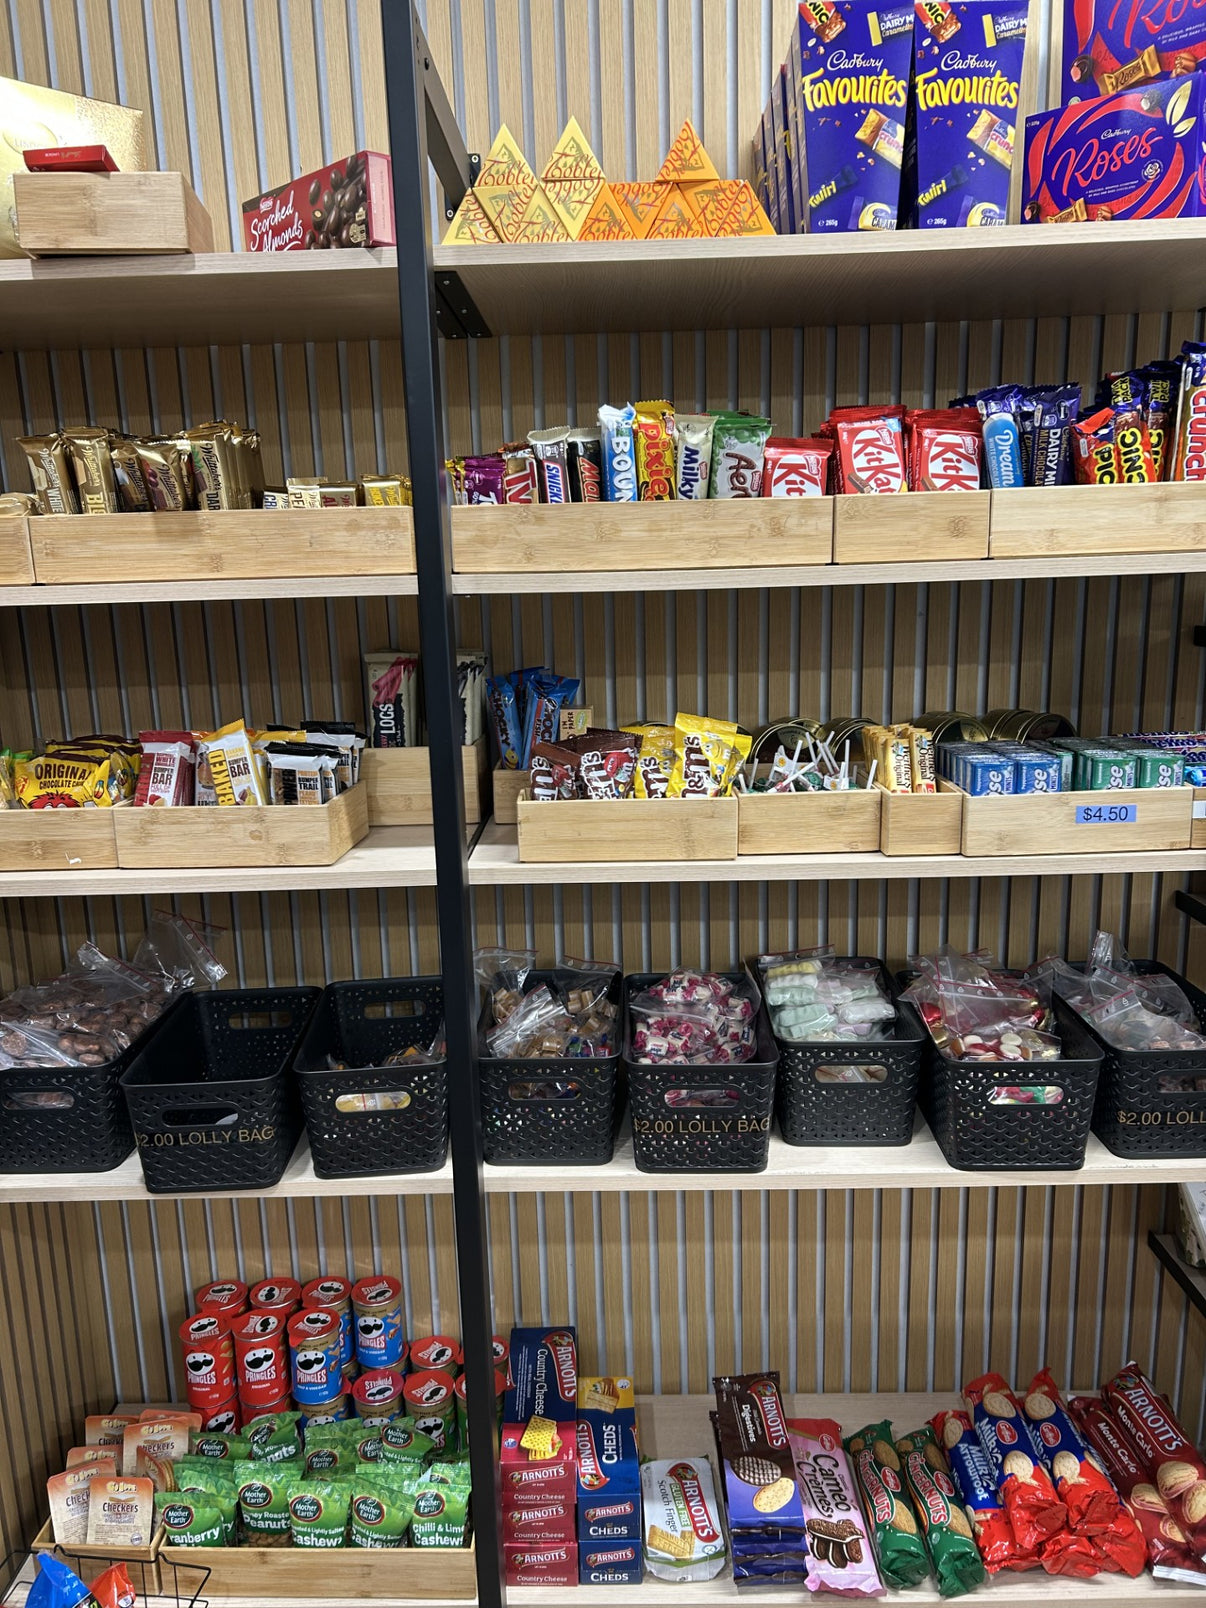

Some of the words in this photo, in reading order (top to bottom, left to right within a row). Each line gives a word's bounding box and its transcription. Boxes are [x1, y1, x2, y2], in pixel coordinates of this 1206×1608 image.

[880, 17, 905, 31] DAIRY
[994, 18, 1019, 33] DAIRY
[827, 50, 885, 72] Cadbury
[941, 50, 998, 73] Cadbury
[802, 67, 908, 113] Favourites
[915, 67, 1019, 113] Favourites
[1100, 128, 1132, 140] Cadbury
[1051, 127, 1164, 197] Roses
[250, 189, 295, 251] Scorched
[262, 212, 304, 252] Almonds
[1121, 376, 1133, 404] PACK
[994, 429, 1015, 487] Dream
[1047, 428, 1060, 470] DAIRY
[678, 445, 701, 500] Milky
[930, 441, 979, 491] KitK
[379, 702, 395, 735] LOGS
[229, 762, 250, 779] BAR
[894, 752, 905, 789] Original
[918, 746, 929, 781] Original
[152, 772, 173, 785] BAR
[208, 749, 237, 807] BAKED
[298, 782, 319, 791] TRAIL
[1083, 805, 1128, 823] $4.50
[634, 1118, 674, 1134] $2.00
[679, 1119, 733, 1133] LOLLY
[737, 1118, 771, 1133] BAG
[1117, 1110, 1162, 1126] $2.00
[1166, 1110, 1206, 1126] LOLL
[178, 1130, 232, 1147] LOLLY
[238, 1125, 276, 1143] BAG
[358, 1335, 386, 1350] PRINGLES
[533, 1347, 549, 1381] Country
[187, 1371, 217, 1386] PRINGLES
[245, 1368, 277, 1383] PRINGLES
[296, 1368, 327, 1384] PRINGLES
[534, 1382, 548, 1415] Cheese
[741, 1404, 757, 1443] Digestives
[1125, 1386, 1182, 1452] ARNOTT'S
[1117, 1405, 1134, 1432] Monte
[1131, 1430, 1154, 1458] Carlo
[202, 1443, 223, 1451] Mother
[602, 1423, 617, 1465] CHEDS
[1098, 1422, 1118, 1450] Monte
[1116, 1449, 1137, 1474] Carlo
[958, 1442, 990, 1502] Arrowroot
[669, 1481, 684, 1507] GLUTEN
[812, 1453, 852, 1514] Cameo
[859, 1449, 893, 1525] GINGERNUTS
[908, 1451, 947, 1525] GINGERNUTS
[65, 1488, 90, 1508] Check
[244, 1490, 267, 1499] Mother
[246, 1497, 264, 1505] Earth
[513, 1493, 540, 1501] Country
[102, 1501, 139, 1514] Checkers
[168, 1510, 189, 1518] Mother
[295, 1504, 317, 1513] Mother
[358, 1505, 381, 1516] Mother
[657, 1479, 671, 1509] Scotch
[665, 1508, 679, 1534] Finger
[170, 1516, 187, 1525] Earth
[676, 1507, 692, 1528] FREE
[169, 1526, 220, 1544] ranberry
[412, 1523, 436, 1534] Chilli
[437, 1524, 444, 1533] &
[513, 1531, 540, 1540] Country
[589, 1526, 629, 1536] CHEDS
[516, 1574, 543, 1583] Country
[590, 1572, 629, 1582] CHEDS
